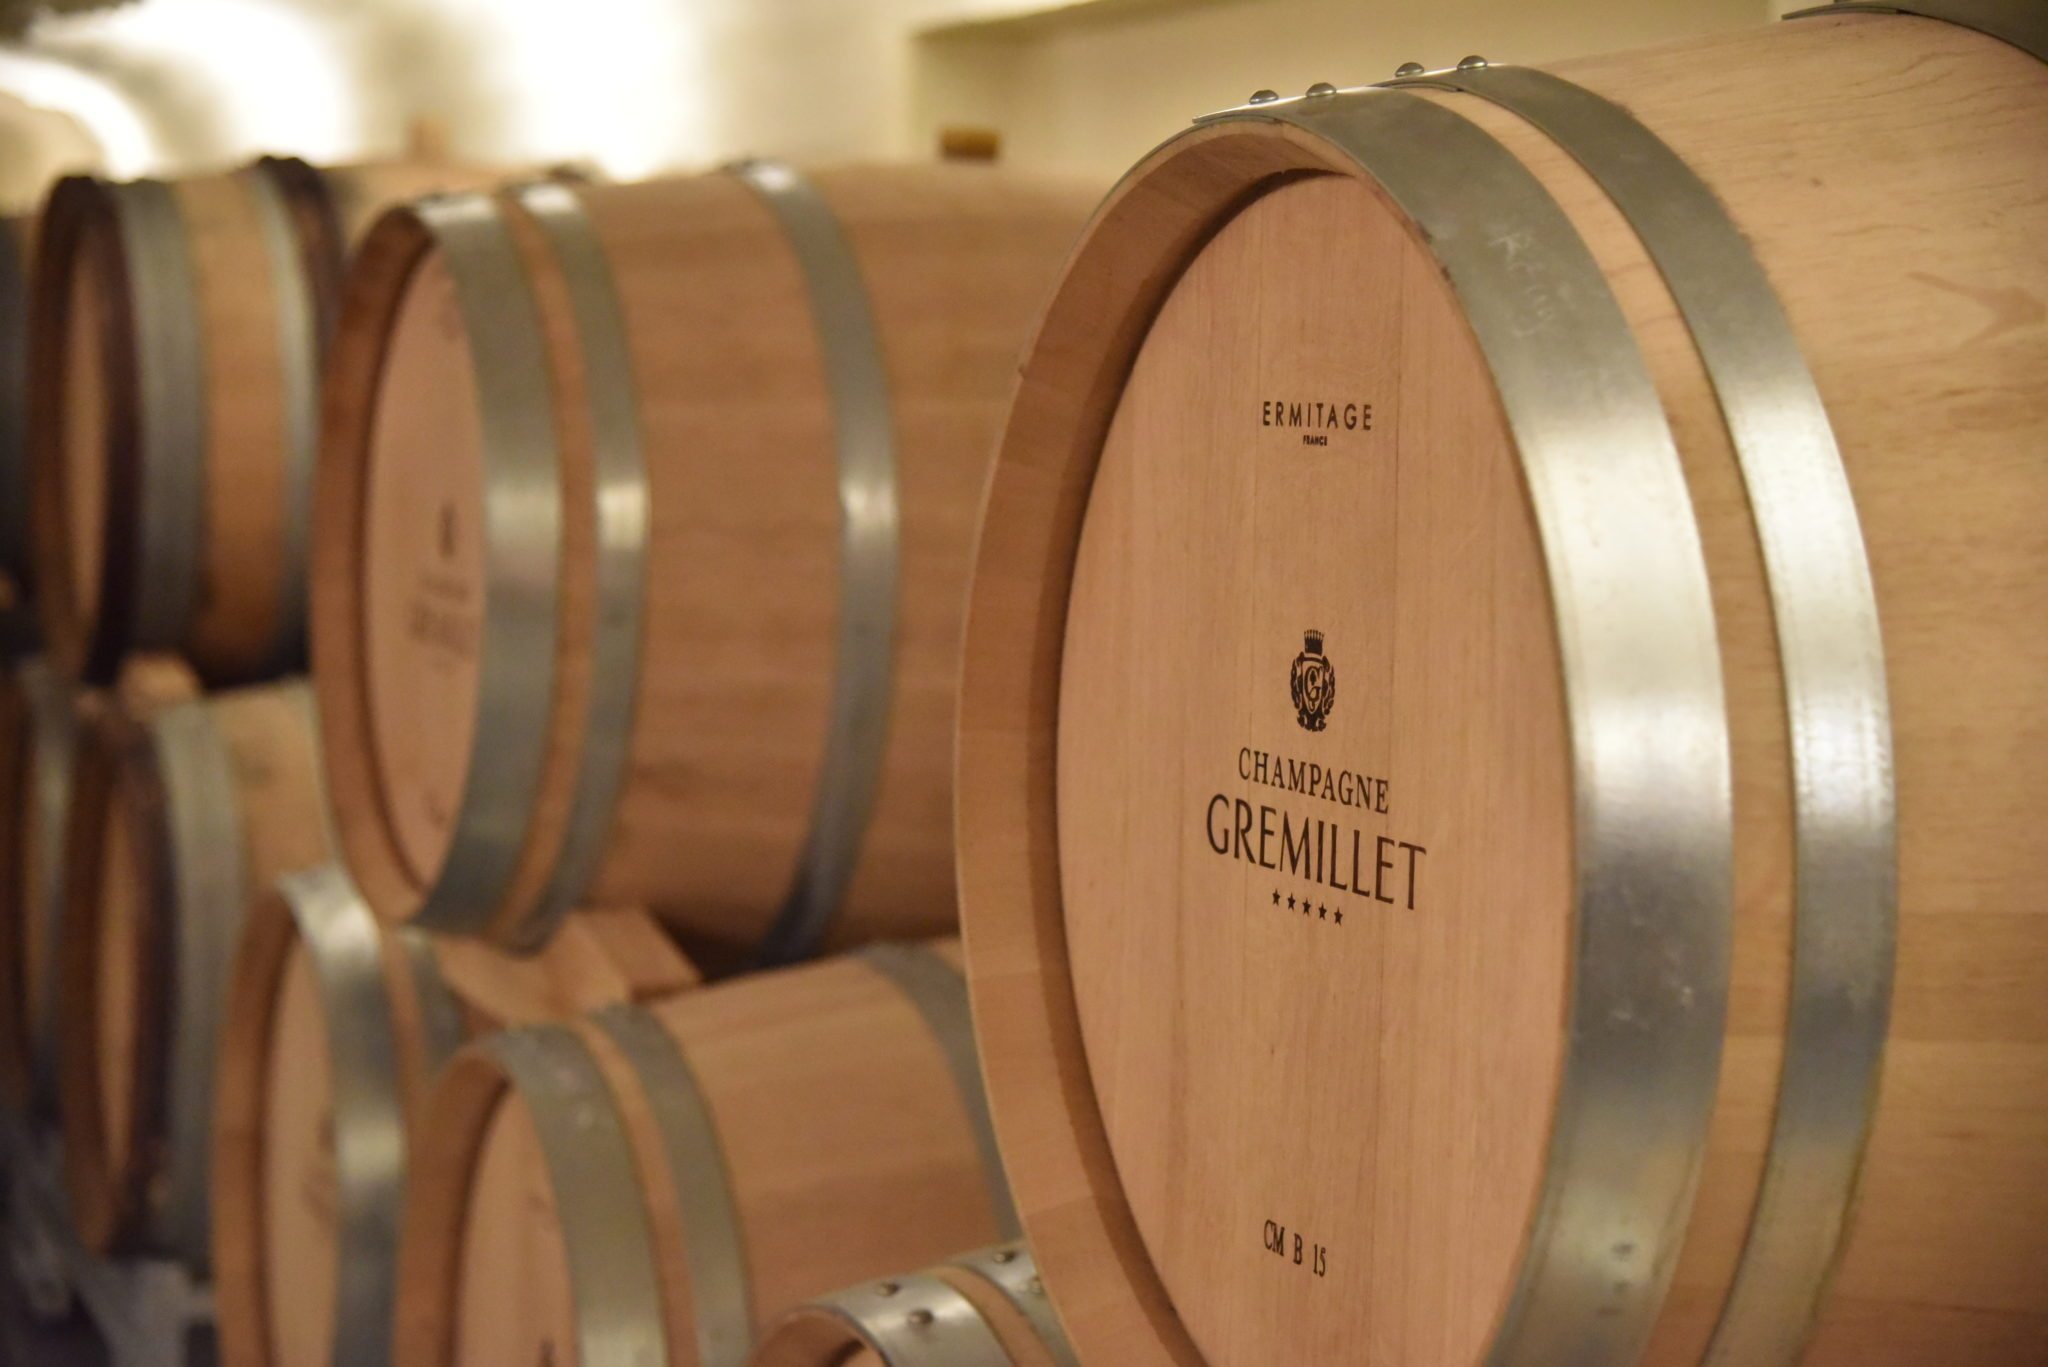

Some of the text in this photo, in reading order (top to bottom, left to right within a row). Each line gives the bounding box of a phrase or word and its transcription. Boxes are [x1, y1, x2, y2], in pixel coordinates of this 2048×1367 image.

[1262, 401, 1372, 431] ERMITAGE
[1303, 435, 1328, 446] FRANCE
[1239, 747, 1389, 815] CHAMPAGNE
[1207, 794, 1427, 911] GREMILLET
[1264, 1219, 1327, 1278] CM B 15
